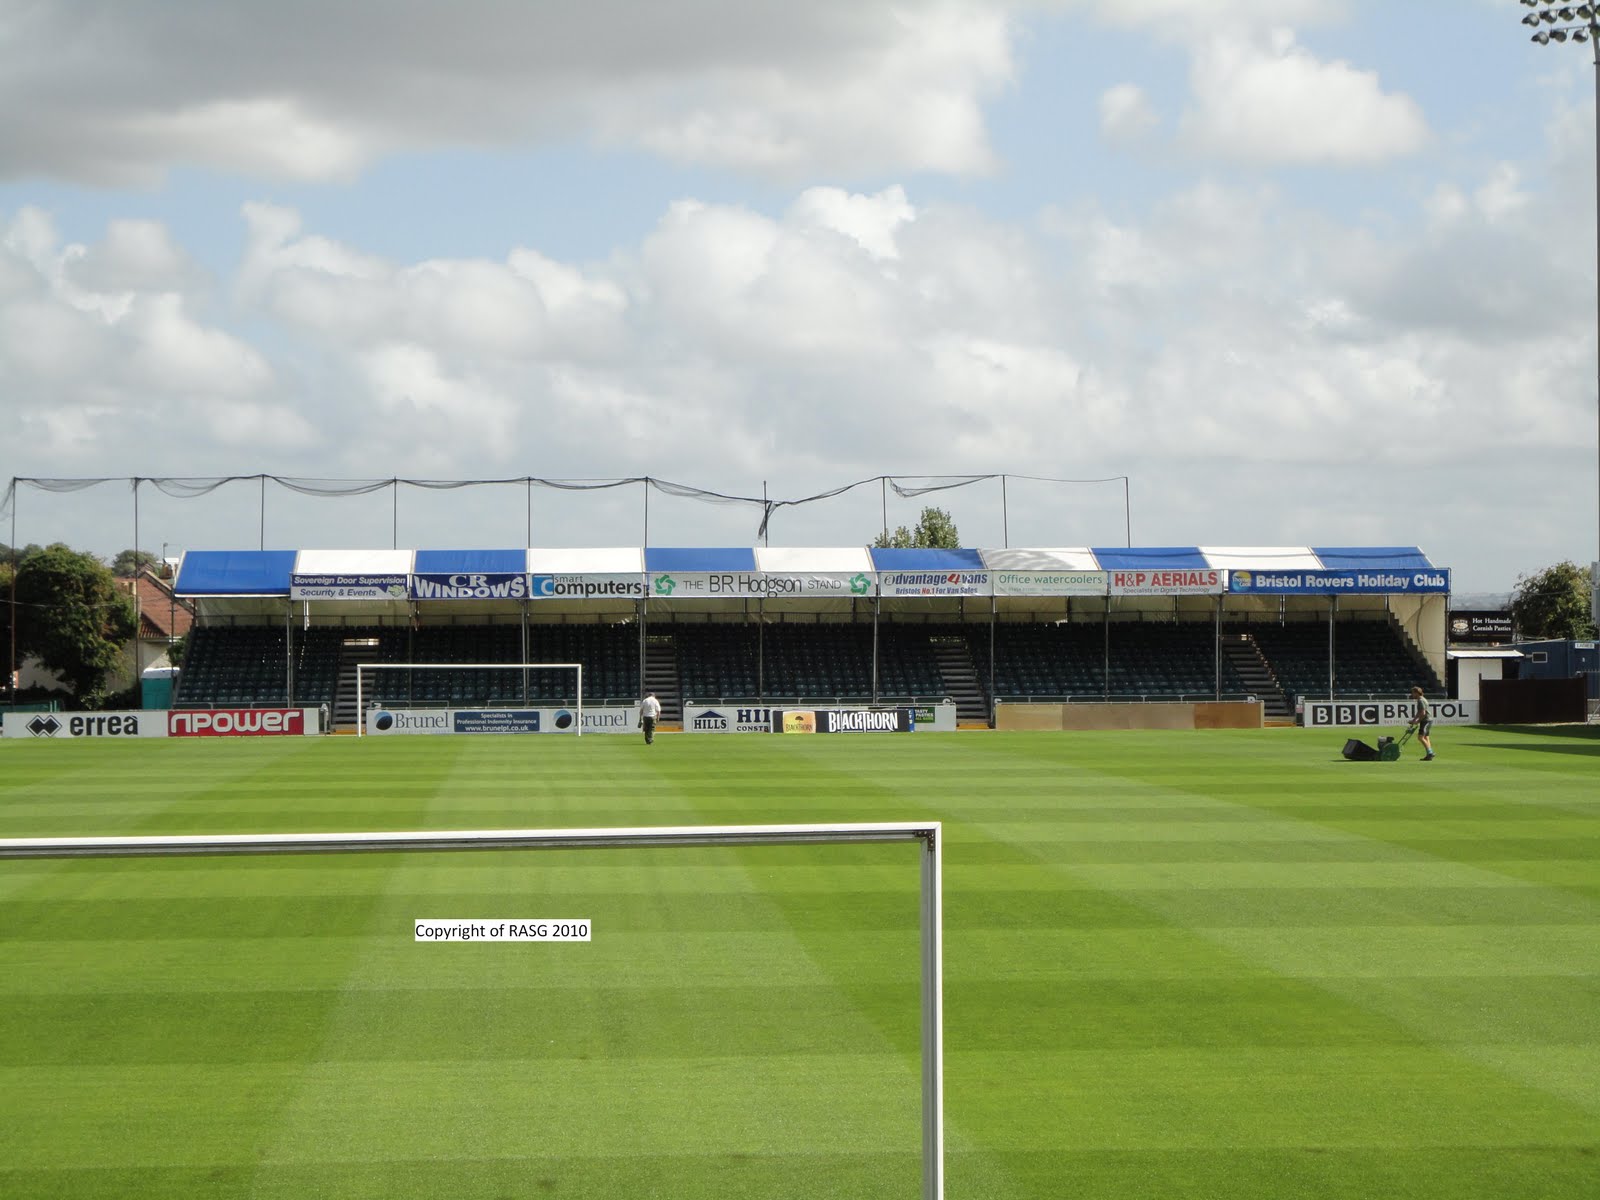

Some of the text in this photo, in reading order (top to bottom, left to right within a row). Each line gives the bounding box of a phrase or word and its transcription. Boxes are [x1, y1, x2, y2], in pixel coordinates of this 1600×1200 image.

[294, 577, 334, 585] Sovereign
[358, 577, 406, 586] Supervision
[413, 575, 525, 598] WINDOWS
[449, 575, 490, 587] CR
[683, 580, 704, 589] THE
[807, 580, 842, 589] STAND
[999, 574, 1103, 585] Office watercoolers
[1115, 572, 1218, 587] H&P AERIALS
[1256, 574, 1445, 588] Bristol Rovers Holiday Club
[300, 589, 335, 597] Security
[541, 579, 642, 597] Computers
[1383, 703, 1469, 719] BRITOL
[171, 712, 300, 733] npower
[394, 711, 450, 729] Brunel
[694, 719, 727, 729] HILLS
[828, 711, 899, 732] BLACKTHORN
